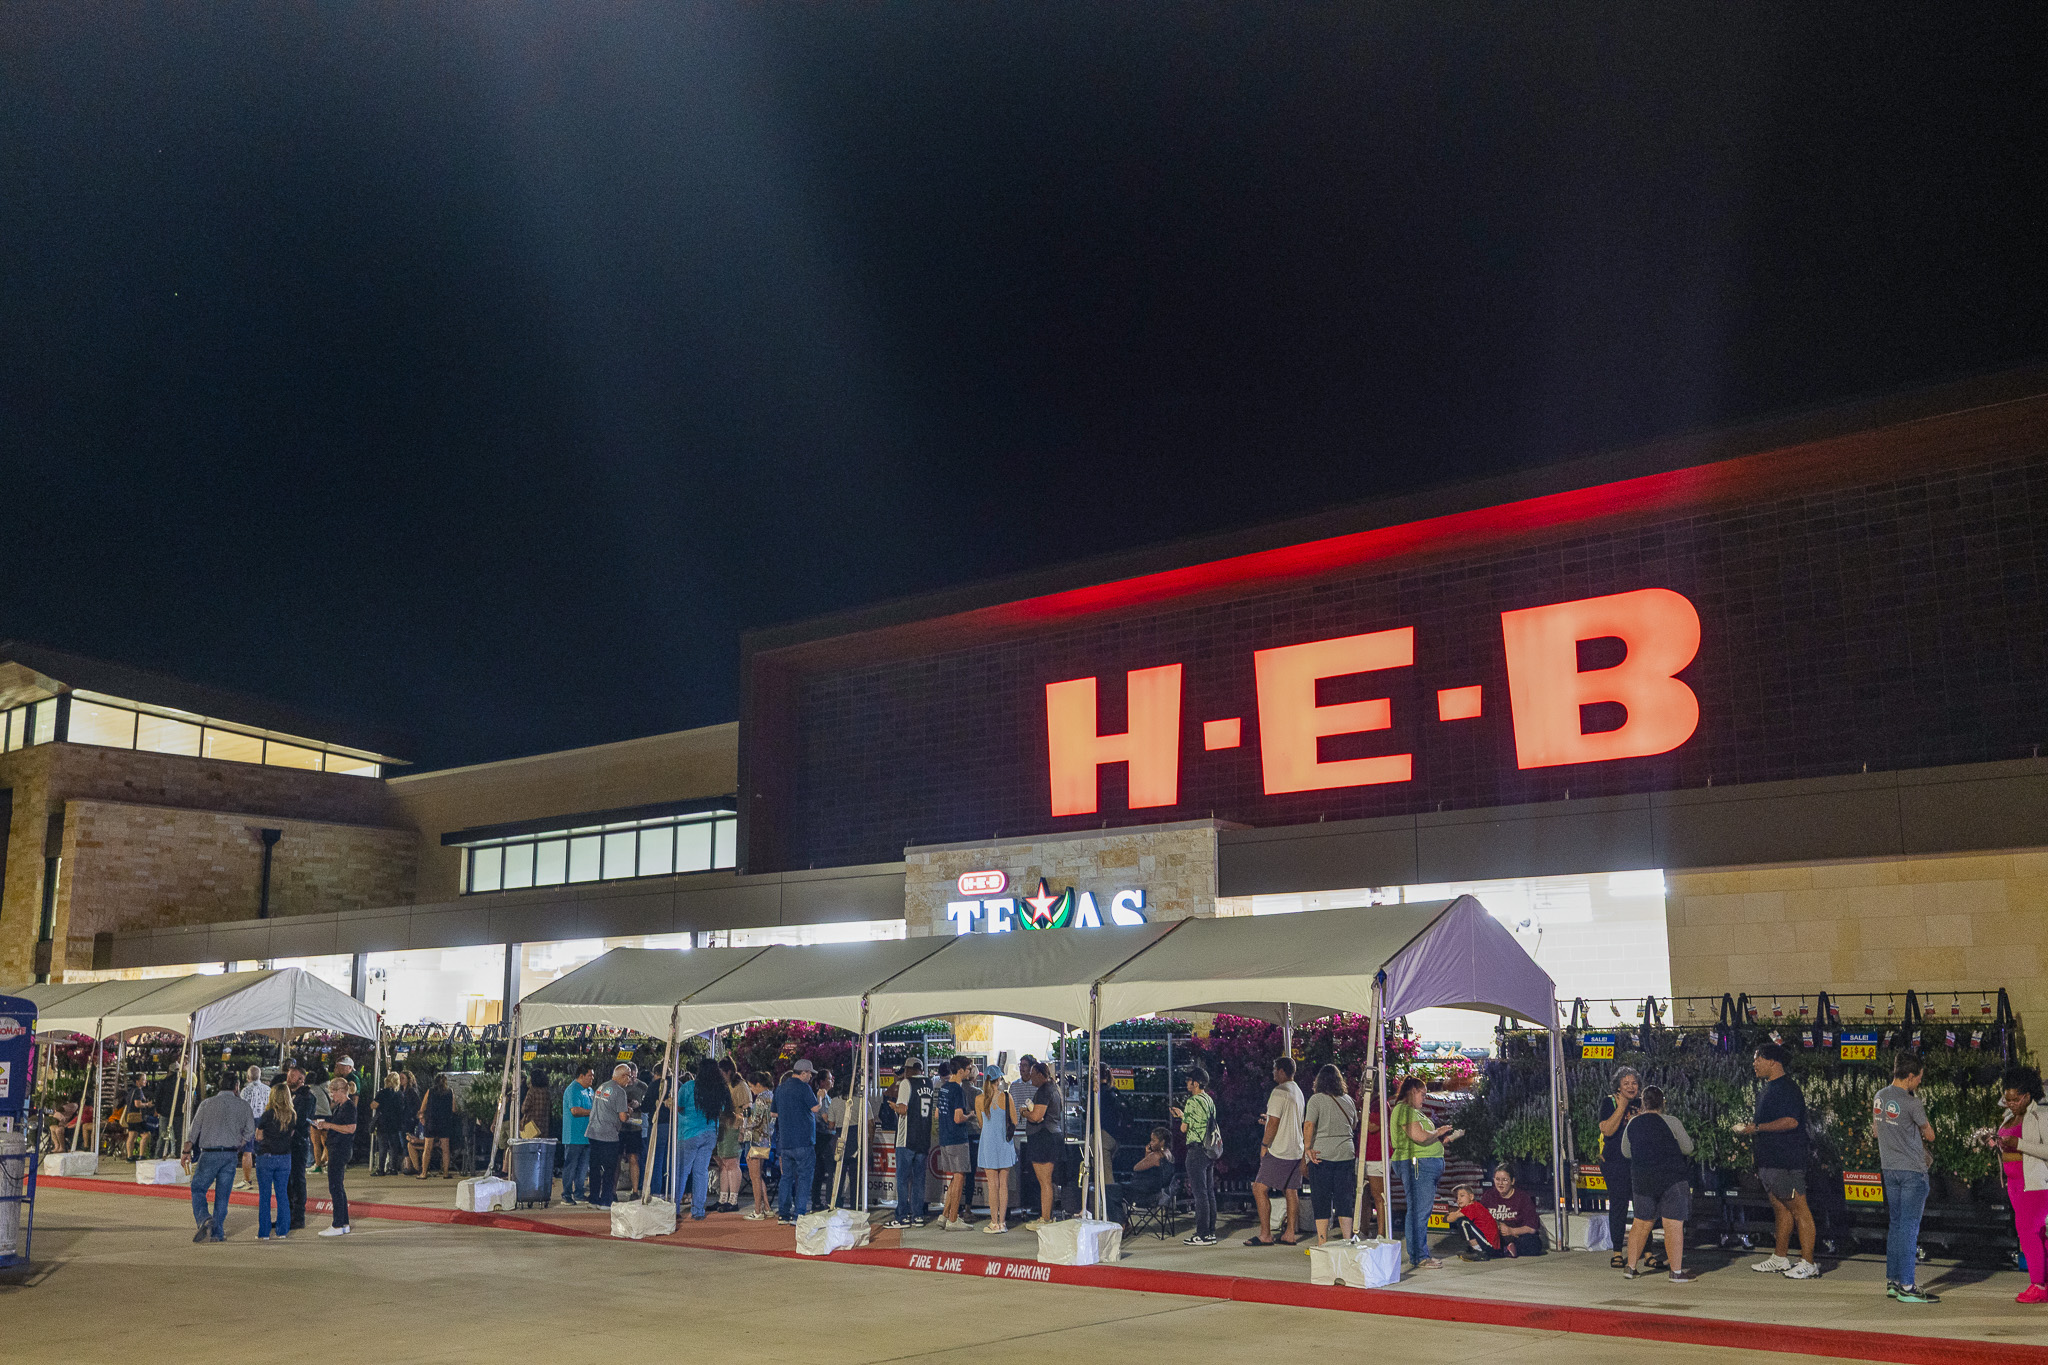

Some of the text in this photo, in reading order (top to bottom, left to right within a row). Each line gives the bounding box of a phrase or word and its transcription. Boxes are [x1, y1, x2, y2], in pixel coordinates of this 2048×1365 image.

[1046, 588, 1701, 817] H-E-B
[962, 876, 1001, 890] H-E-B
[921, 1098, 931, 1117] 5
[868, 1182, 894, 1192] OSPER
[1488, 1207, 1518, 1220] Pepper
[1498, 1204, 1511, 1214] Dr
[909, 1254, 1051, 1281] FIRE LANE NO PARKING
